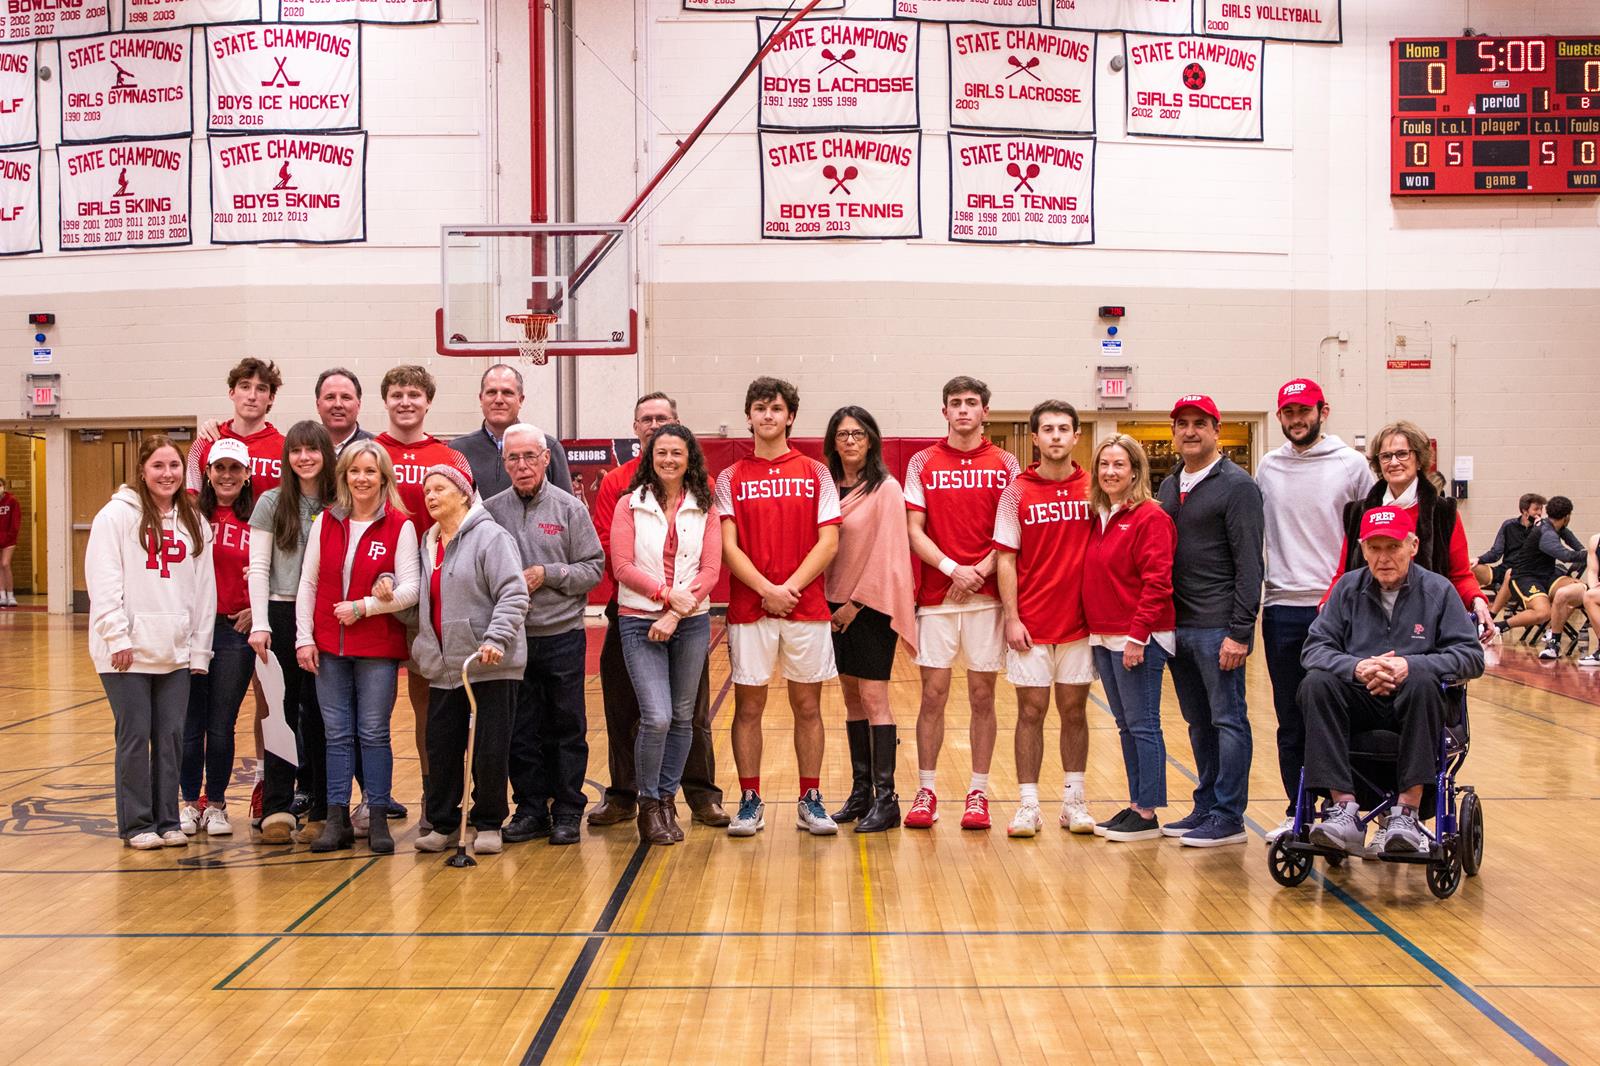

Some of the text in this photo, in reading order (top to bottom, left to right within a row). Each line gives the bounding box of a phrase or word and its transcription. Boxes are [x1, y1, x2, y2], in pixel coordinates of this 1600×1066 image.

[8, 0, 84, 14] BOWLING
[283, 7, 304, 17] 2020
[898, 2, 918, 13] 2015
[1056, 0, 1075, 10] 2004
[10, 15, 30, 26] 2002
[34, 12, 55, 23] 2003
[153, 10, 175, 20] 2003
[1222, 4, 1322, 23] GIRLS VOLLEYBALL
[10, 27, 30, 38] 2016
[34, 25, 55, 35] 2017
[1208, 20, 1229, 31] 2000
[213, 29, 352, 59] STATE CHAMPIONS
[821, 25, 908, 53] CHAMPIONS
[68, 38, 183, 69] STATE CHAMPIONS
[955, 31, 1089, 63] STATE CHAMPIONS
[1406, 43, 1440, 58] Home
[1558, 42, 1600, 57] Guests
[1131, 41, 1257, 72] STATE CHAMPIONS
[1478, 40, 1545, 72] 5:00
[763, 77, 914, 92] BOYS LACROSSE
[1427, 62, 1446, 94] 0
[68, 86, 183, 108] GIRLS GYMNASTICS
[964, 83, 1082, 103] GIRLS LACROSSE
[218, 94, 350, 110] BOYS ICE HOCKEY
[764, 96, 857, 108] 1991 1992 1995 1998
[955, 99, 980, 110] 2003
[1137, 91, 1252, 111] GIRLS SOCCER
[1482, 94, 1520, 112] period
[84, 111, 101, 121] 2003
[211, 115, 264, 125] 2013 2016
[1131, 107, 1181, 119] 2002 2007
[1403, 121, 1431, 134] fouls
[1481, 120, 1520, 135] player
[1570, 120, 1599, 132] fouls
[220, 139, 354, 168] STATE CHAMPIONS
[769, 138, 912, 167] STATE CHAMPIONS
[960, 142, 1083, 171] STATE CHAMPIONS
[1413, 143, 1427, 165] 0
[1448, 142, 1461, 165] 5
[1541, 142, 1555, 164] 5
[1581, 141, 1595, 164] 0
[68, 147, 181, 176] STATE CHAMPIONS
[1405, 176, 1429, 187] won
[1485, 174, 1516, 188] game
[1573, 174, 1597, 185] won
[78, 197, 171, 216] GIRLS SKIING
[233, 193, 340, 209] BOYS SKIING
[967, 193, 1077, 211] GIRLS TENNIS
[214, 211, 308, 223] 2010 2011 2012 2013
[780, 203, 903, 218] BOYS TENNIS
[62, 214, 187, 230] 1998 2001 2009 2011 2013 2014
[978, 212, 997, 223] 1998
[1002, 212, 1021, 222] 2001
[1024, 212, 1044, 223] 2002
[1048, 214, 1067, 225] 2003
[1071, 214, 1089, 225] 2004
[766, 221, 850, 233] 2001 2009 2013
[954, 224, 997, 236] 2005 2010
[62, 228, 187, 243] 2015 2016 2017 2018 2019 2020
[1106, 380, 1123, 395] EXIT
[36, 388, 51, 403] EXIT
[567, 450, 606, 461] SENIORS
[392, 464, 425, 484] SUI
[926, 469, 1008, 490] JESUITS
[736, 478, 815, 501] JESUITS
[1024, 500, 1091, 526] JESUIT
[1369, 512, 1396, 523] PREP
[368, 541, 387, 560] FP
